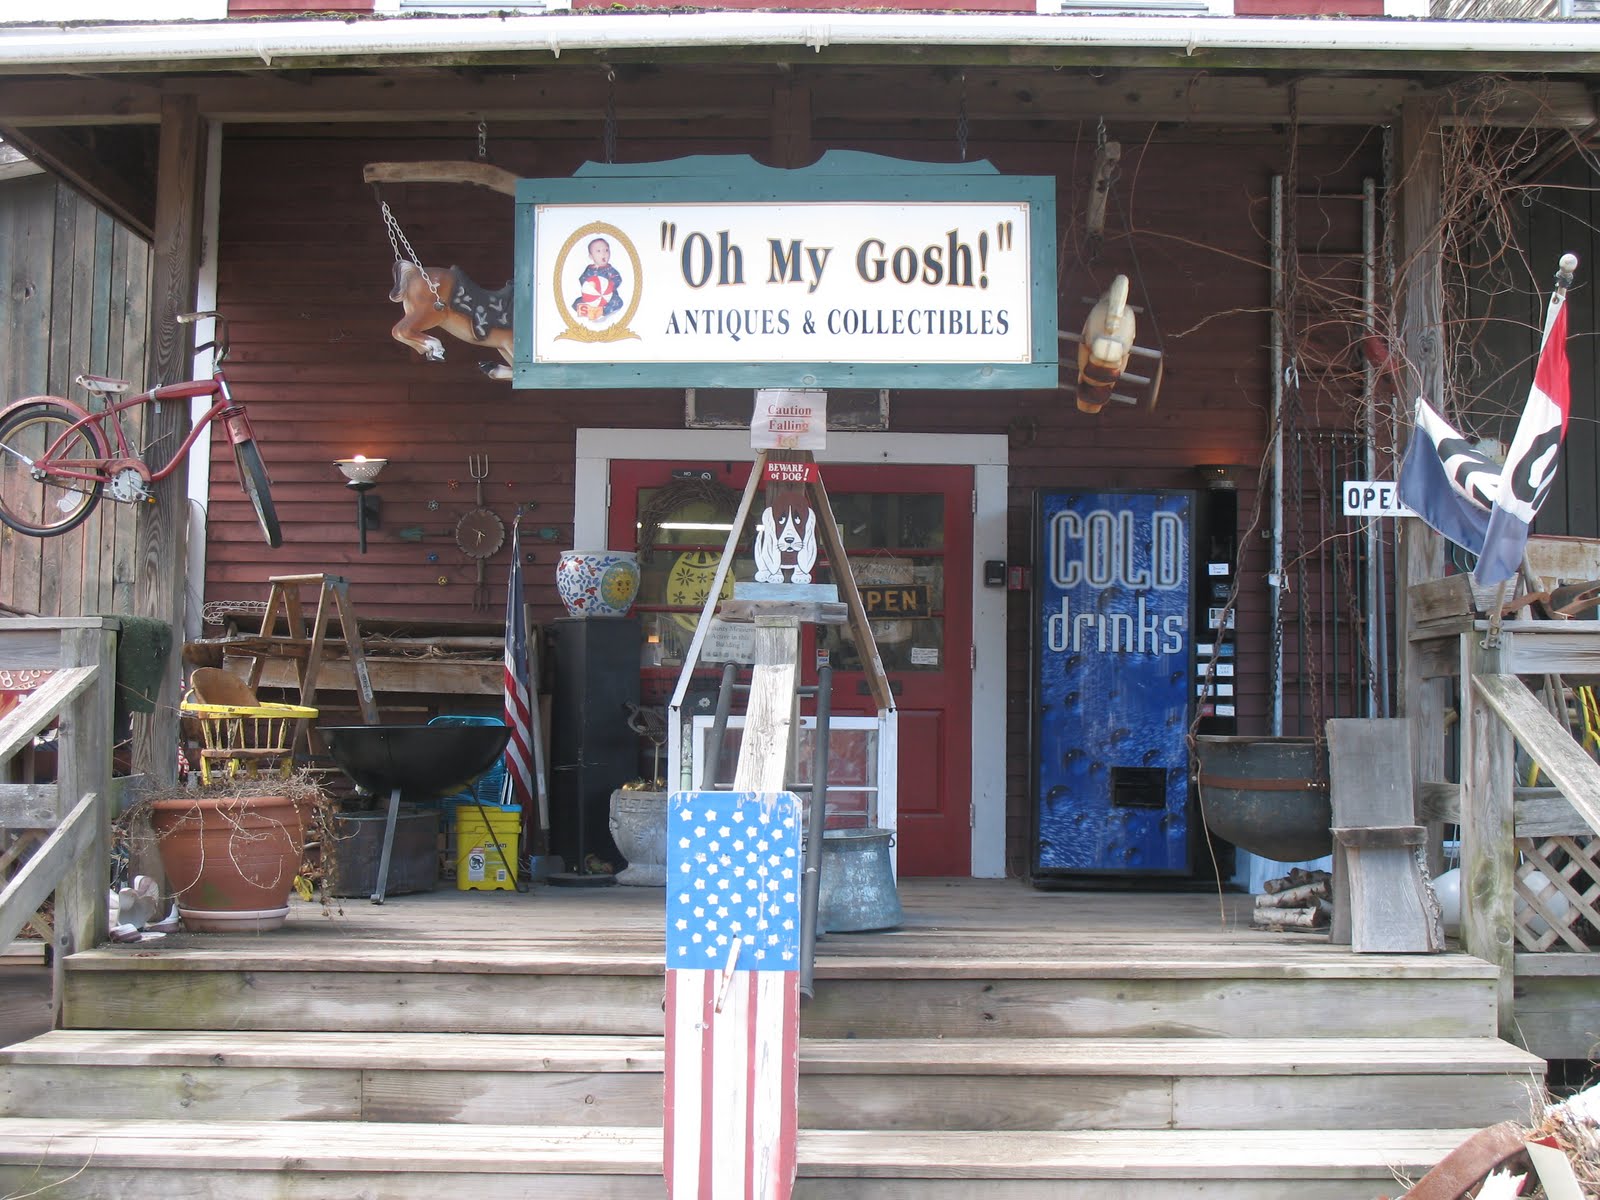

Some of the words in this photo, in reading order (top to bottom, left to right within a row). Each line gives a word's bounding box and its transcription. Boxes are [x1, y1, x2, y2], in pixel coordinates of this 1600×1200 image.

[660, 220, 746, 290] "Oh
[767, 238, 834, 294] My
[855, 220, 1013, 290] Gosh!"
[665, 308, 790, 342] ANTIQUES
[802, 310, 816, 335] &
[827, 308, 1009, 336] COLLECTIBLES
[768, 405, 812, 416] Caution
[769, 420, 809, 432] Falling
[768, 463, 804, 472] BEWARE
[1050, 510, 1183, 589] COLD
[860, 590, 918, 612] PEN
[1048, 596, 1183, 655] drinks
